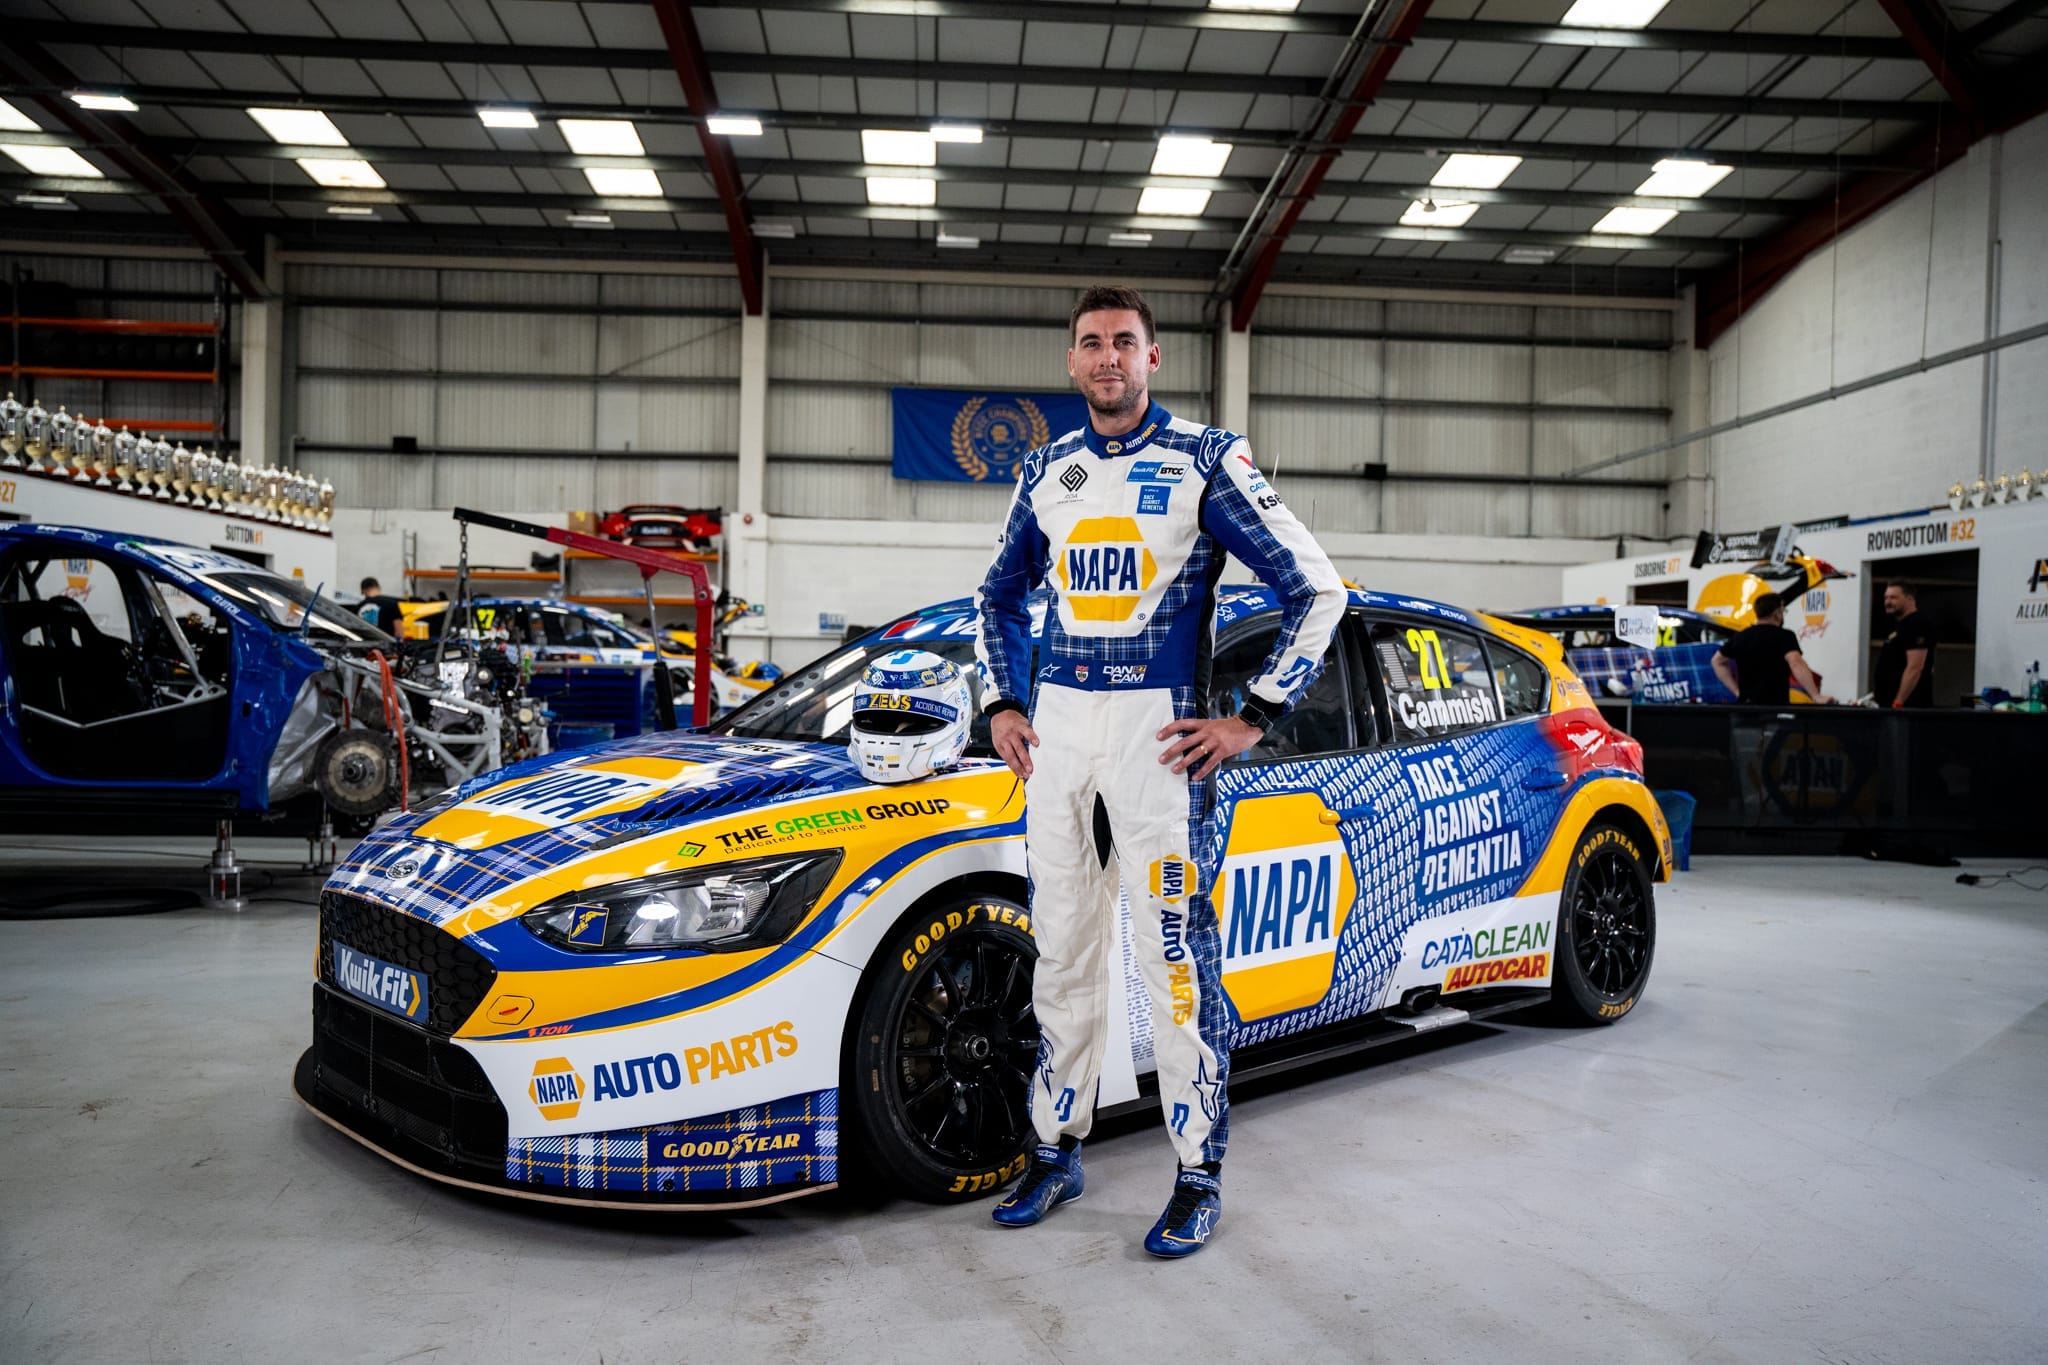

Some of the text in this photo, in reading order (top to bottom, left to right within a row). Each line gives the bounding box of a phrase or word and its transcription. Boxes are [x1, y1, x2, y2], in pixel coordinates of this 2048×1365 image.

[1125, 438, 1142, 450] AUTO
[1141, 423, 1158, 441] PARTS
[1160, 467, 1184, 475] BTCC
[0, 480, 16, 503] 27
[225, 524, 254, 544] SUTTON
[1868, 522, 1947, 552] ROWBOTTOM
[1951, 518, 1975, 541] #32
[1069, 547, 1138, 591] NAPA
[1634, 560, 1666, 578] OSBORNE
[212, 595, 241, 616] CLUTCH
[1439, 608, 1468, 622] DENSO
[1805, 590, 1827, 612] NAPA
[473, 609, 496, 630] 27
[1103, 666, 1134, 675] DAN
[1406, 629, 1452, 689] 27
[1111, 674, 1144, 682] CAM
[1643, 681, 1690, 702] GAINST
[869, 693, 912, 711] ZEUS
[914, 700, 942, 714] ACCIDENT
[941, 705, 957, 719] REPAIR
[1398, 689, 1497, 730] Cammish
[1407, 755, 1466, 802] RACE
[475, 772, 652, 820] NAPA
[715, 799, 951, 848] THE GREEN GROUP
[1423, 789, 1502, 850] AGAINST
[724, 824, 867, 855] Dedicated to Service
[1577, 829, 1641, 868] GOODYEAR
[1421, 829, 1522, 896] DEMENTIA
[1226, 855, 1331, 959] NAPA
[1160, 861, 1194, 1027] NAPA AUTO PARTS
[1421, 921, 1551, 970] CATACLEAN
[1446, 954, 1546, 992] AUTOCAR
[1599, 997, 1633, 1018] EAGLE
[539, 1024, 574, 1036] TOW
[536, 1020, 798, 1104] NAPA AUTO PARTS
[663, 1132, 800, 1160] GOODYEAR
[949, 1153, 1026, 1192] EAGLE
